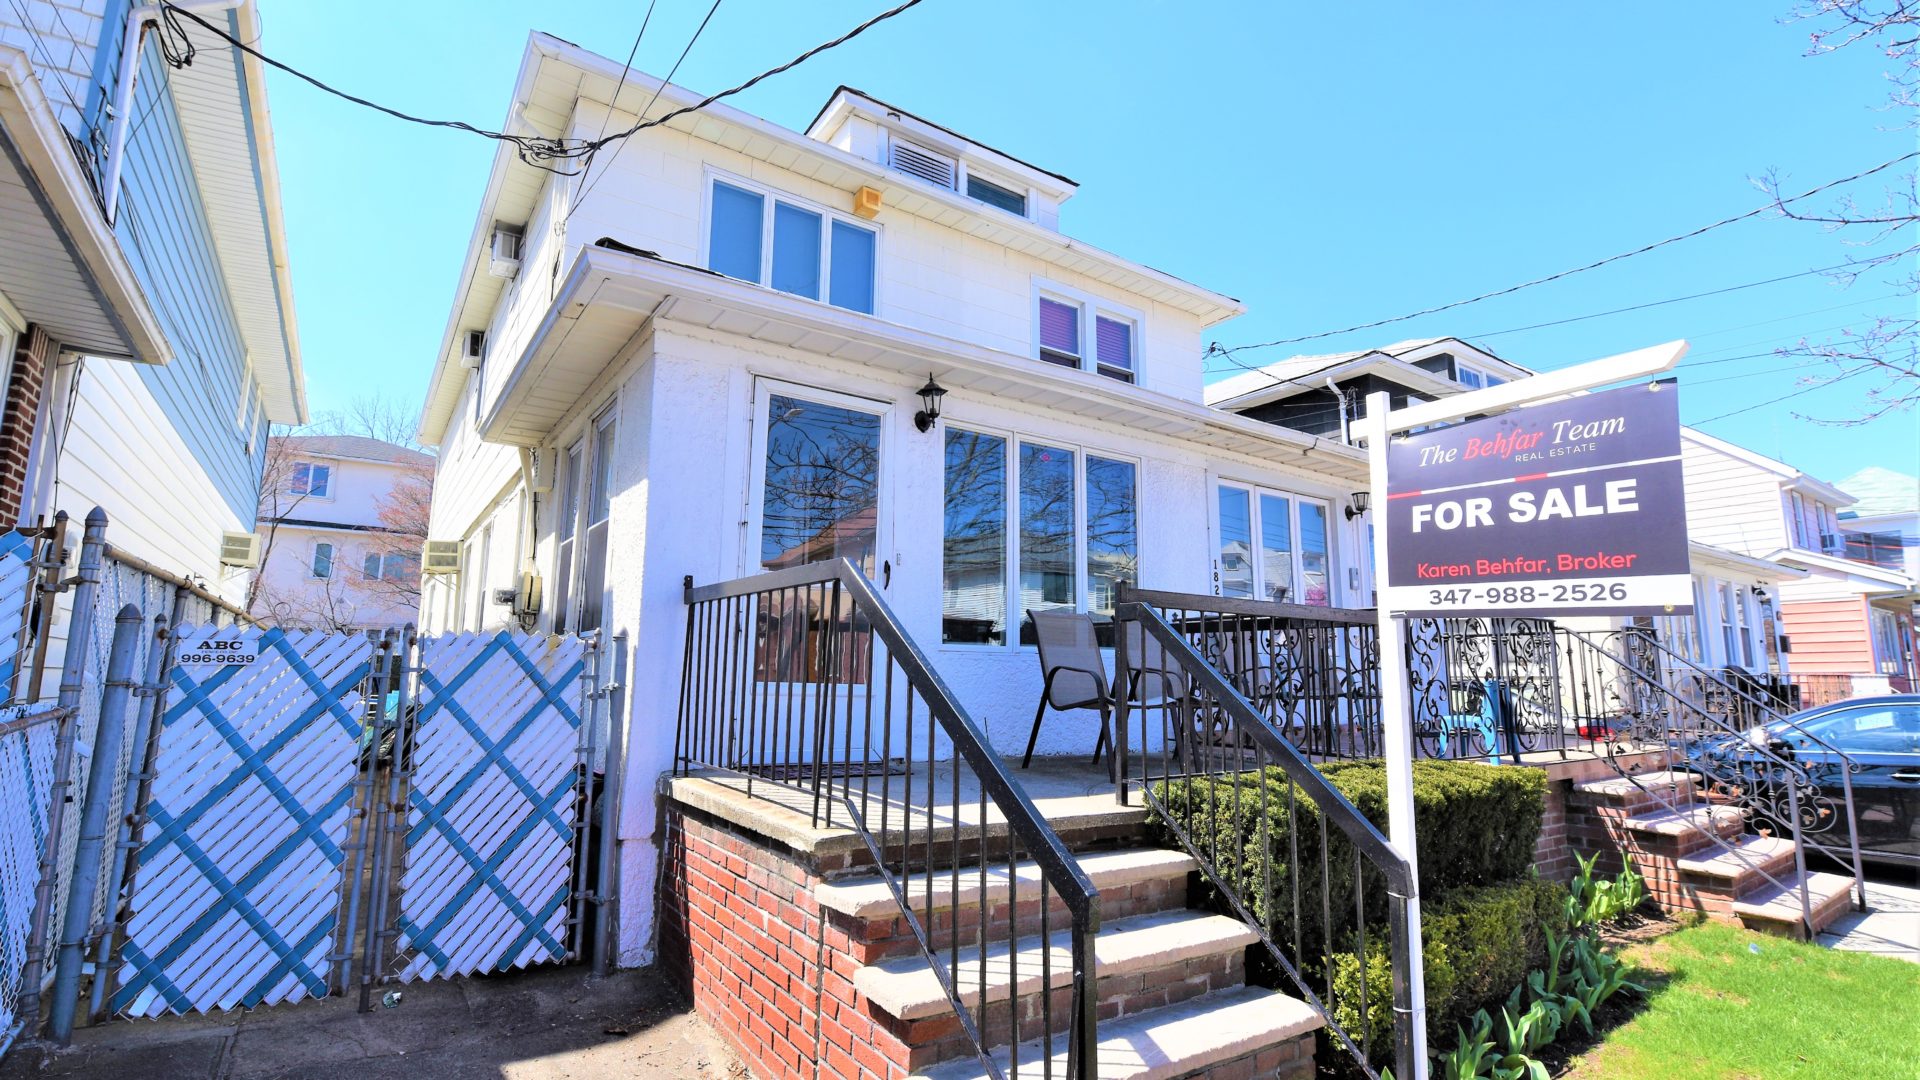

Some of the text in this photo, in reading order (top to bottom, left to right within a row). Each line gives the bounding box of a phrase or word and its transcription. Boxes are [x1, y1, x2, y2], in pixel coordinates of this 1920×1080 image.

[1418, 416, 1626, 467] The Behfar Team
[1515, 442, 1597, 463] REAL ESTATE
[1412, 478, 1640, 533] FOR SALE
[1417, 551, 1637, 579] Karen Behfar, Broker
[1429, 582, 1628, 606] 347-988-2526
[196, 640, 243, 650] ABC
[181, 654, 255, 663] 996-9639
